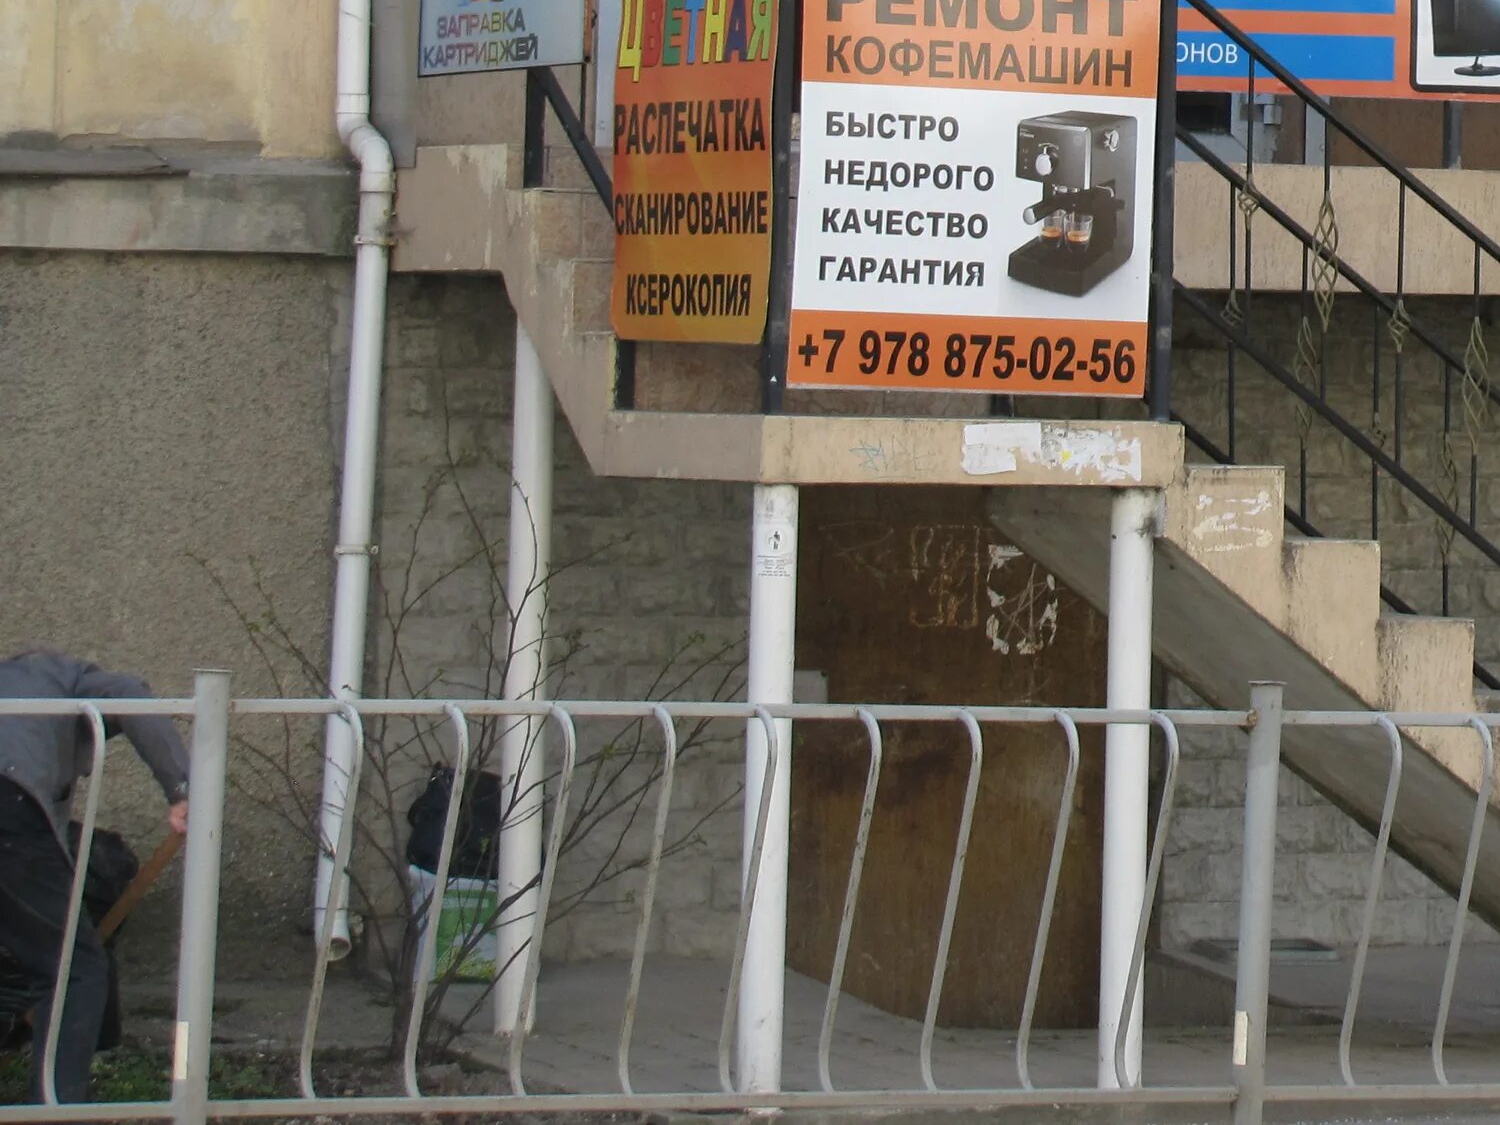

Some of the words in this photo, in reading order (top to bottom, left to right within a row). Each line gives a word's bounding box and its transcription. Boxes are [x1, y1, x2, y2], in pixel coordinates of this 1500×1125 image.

[437, 8, 526, 39] ЗАПРАВКА
[423, 33, 538, 68] КАРТРИДЖЕЙ
[826, 35, 1132, 88] КОФЕМАШИН
[613, 97, 766, 155] РАСПЕЧАТКА
[825, 111, 959, 142] БЫСТРО
[824, 159, 994, 192] НЕДОРОГО
[614, 190, 768, 236] СКАНИРОВАНИЕ
[821, 207, 988, 239] КАЧЕСТВО
[818, 256, 985, 287] ГАРАНТИЯ
[626, 273, 752, 317] КСЕРОКОПИЯ
[798, 329, 846, 373] +7
[859, 331, 931, 377] 978
[944, 334, 1136, 384] 875-02-56
